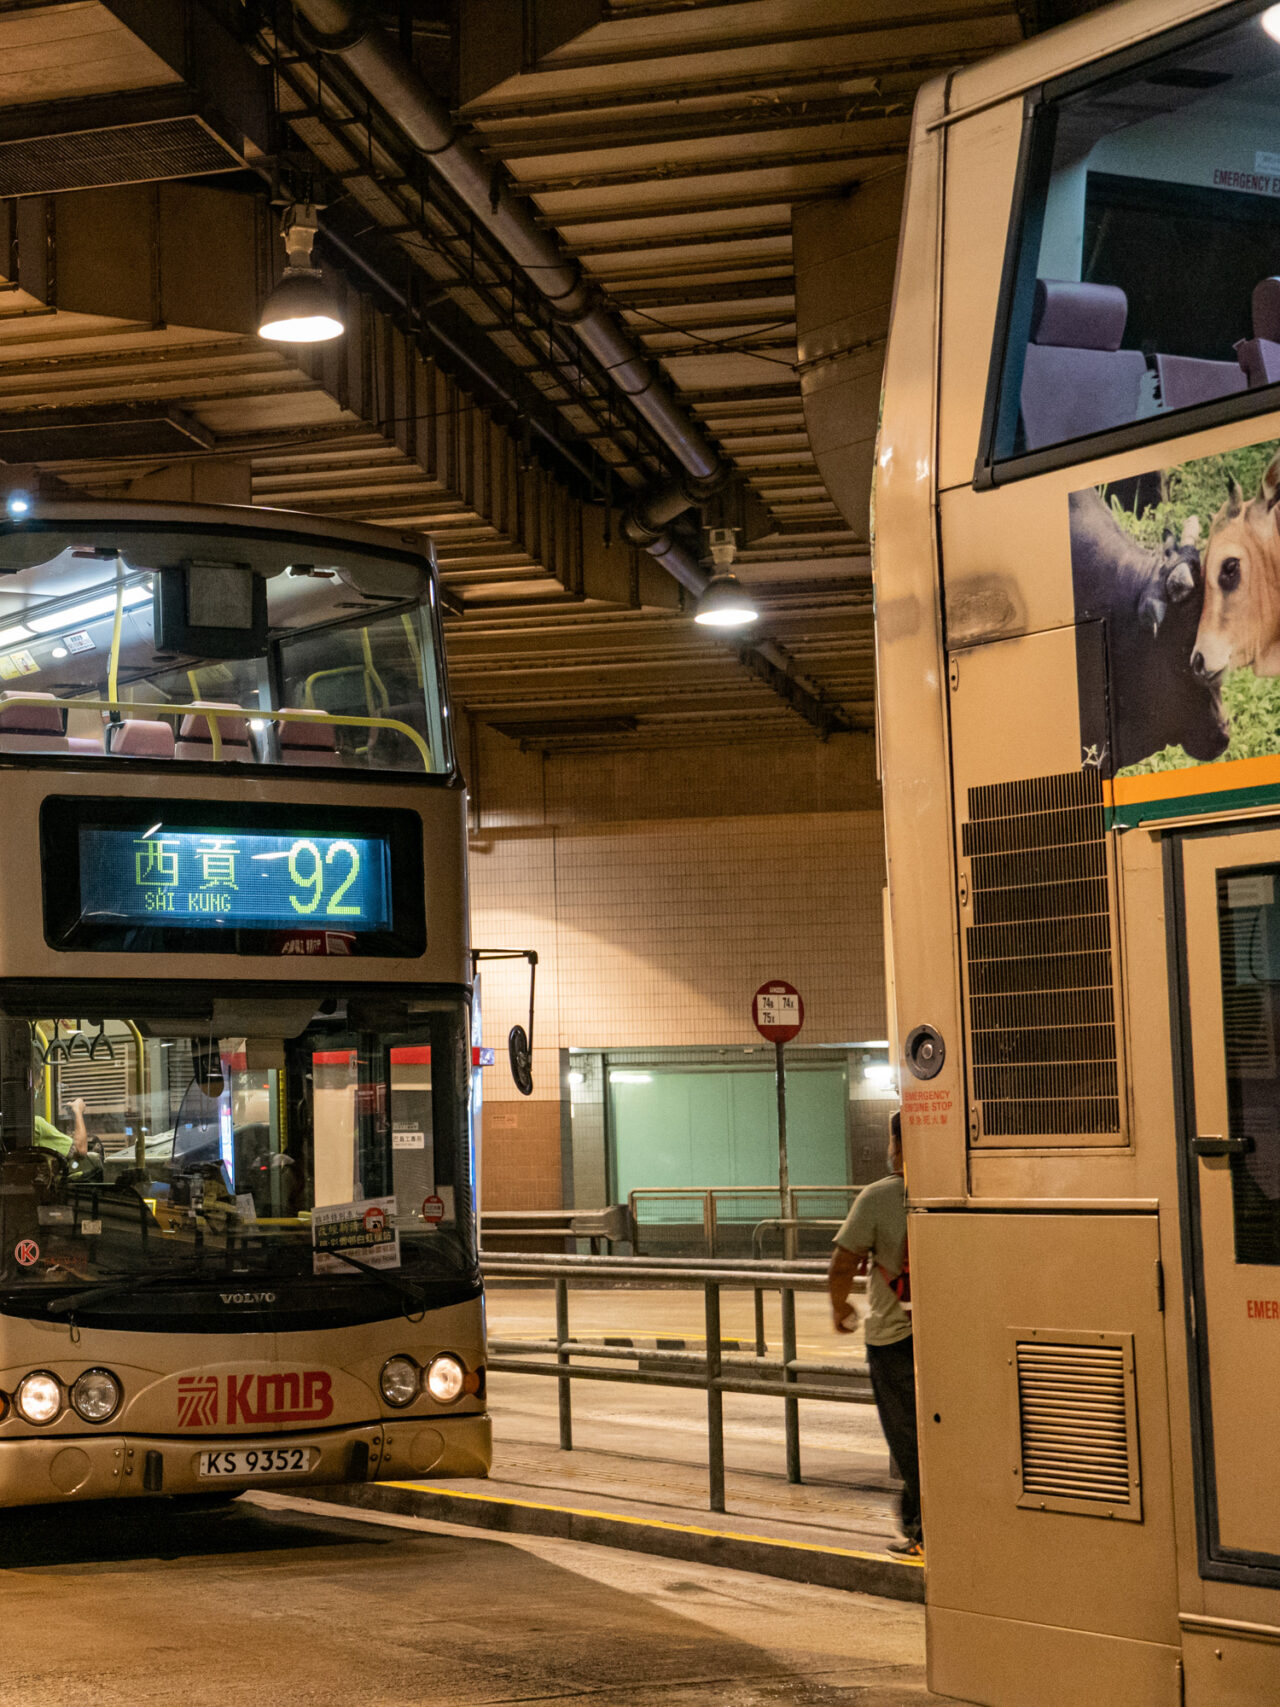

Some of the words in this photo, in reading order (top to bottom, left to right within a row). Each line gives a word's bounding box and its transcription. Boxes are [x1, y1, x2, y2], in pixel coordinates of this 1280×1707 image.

[1213, 168, 1270, 192] EMERGENCY
[133, 839, 241, 890] 西貢
[288, 839, 362, 916] 92
[145, 892, 176, 912] SAI
[189, 892, 232, 913] KUNG
[762, 996, 774, 1008] 74B
[782, 996, 794, 1009] 74X
[904, 1090, 951, 1101] EMERGENCY
[931, 1101, 953, 1112] STOP
[220, 1292, 276, 1304] VOLVO
[207, 1451, 237, 1474] KS
[246, 1449, 304, 1472] 9352
